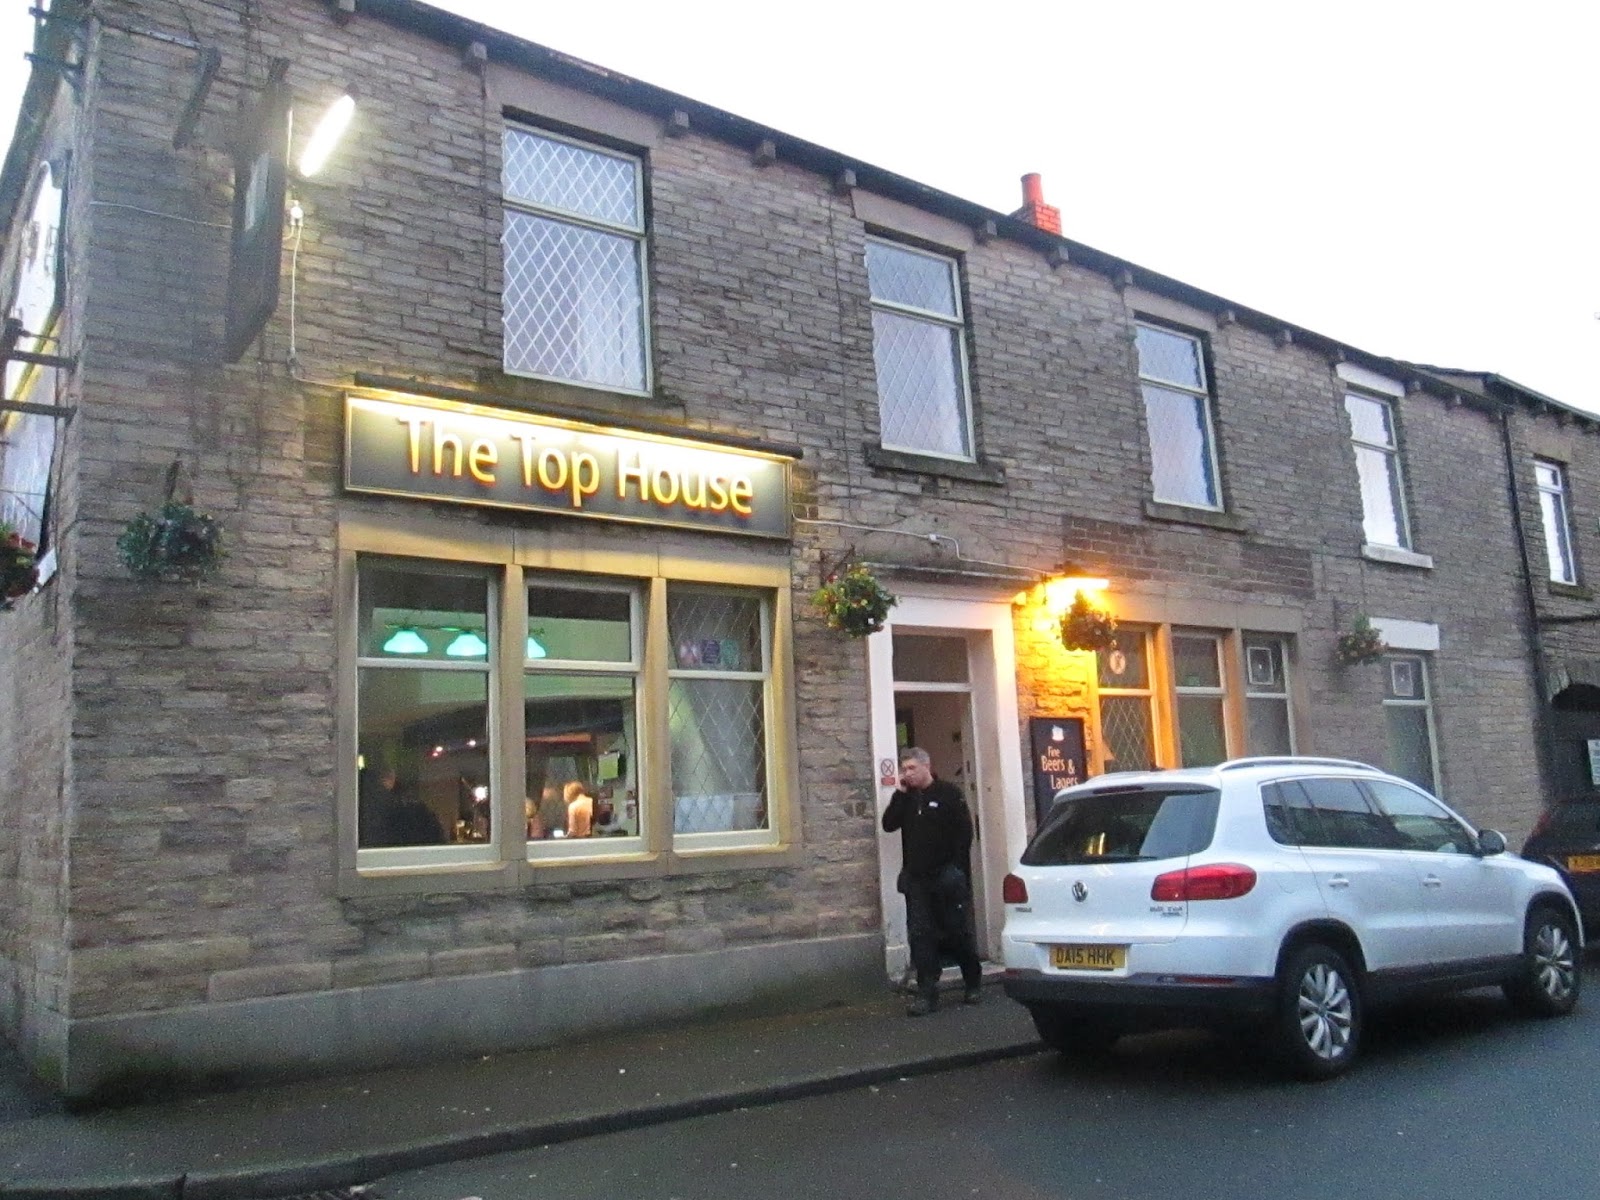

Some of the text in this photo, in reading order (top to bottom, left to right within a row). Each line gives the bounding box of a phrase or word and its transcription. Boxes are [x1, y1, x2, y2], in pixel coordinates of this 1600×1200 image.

[397, 417, 754, 518] The Top House
[1041, 755, 1076, 775] Beers &
